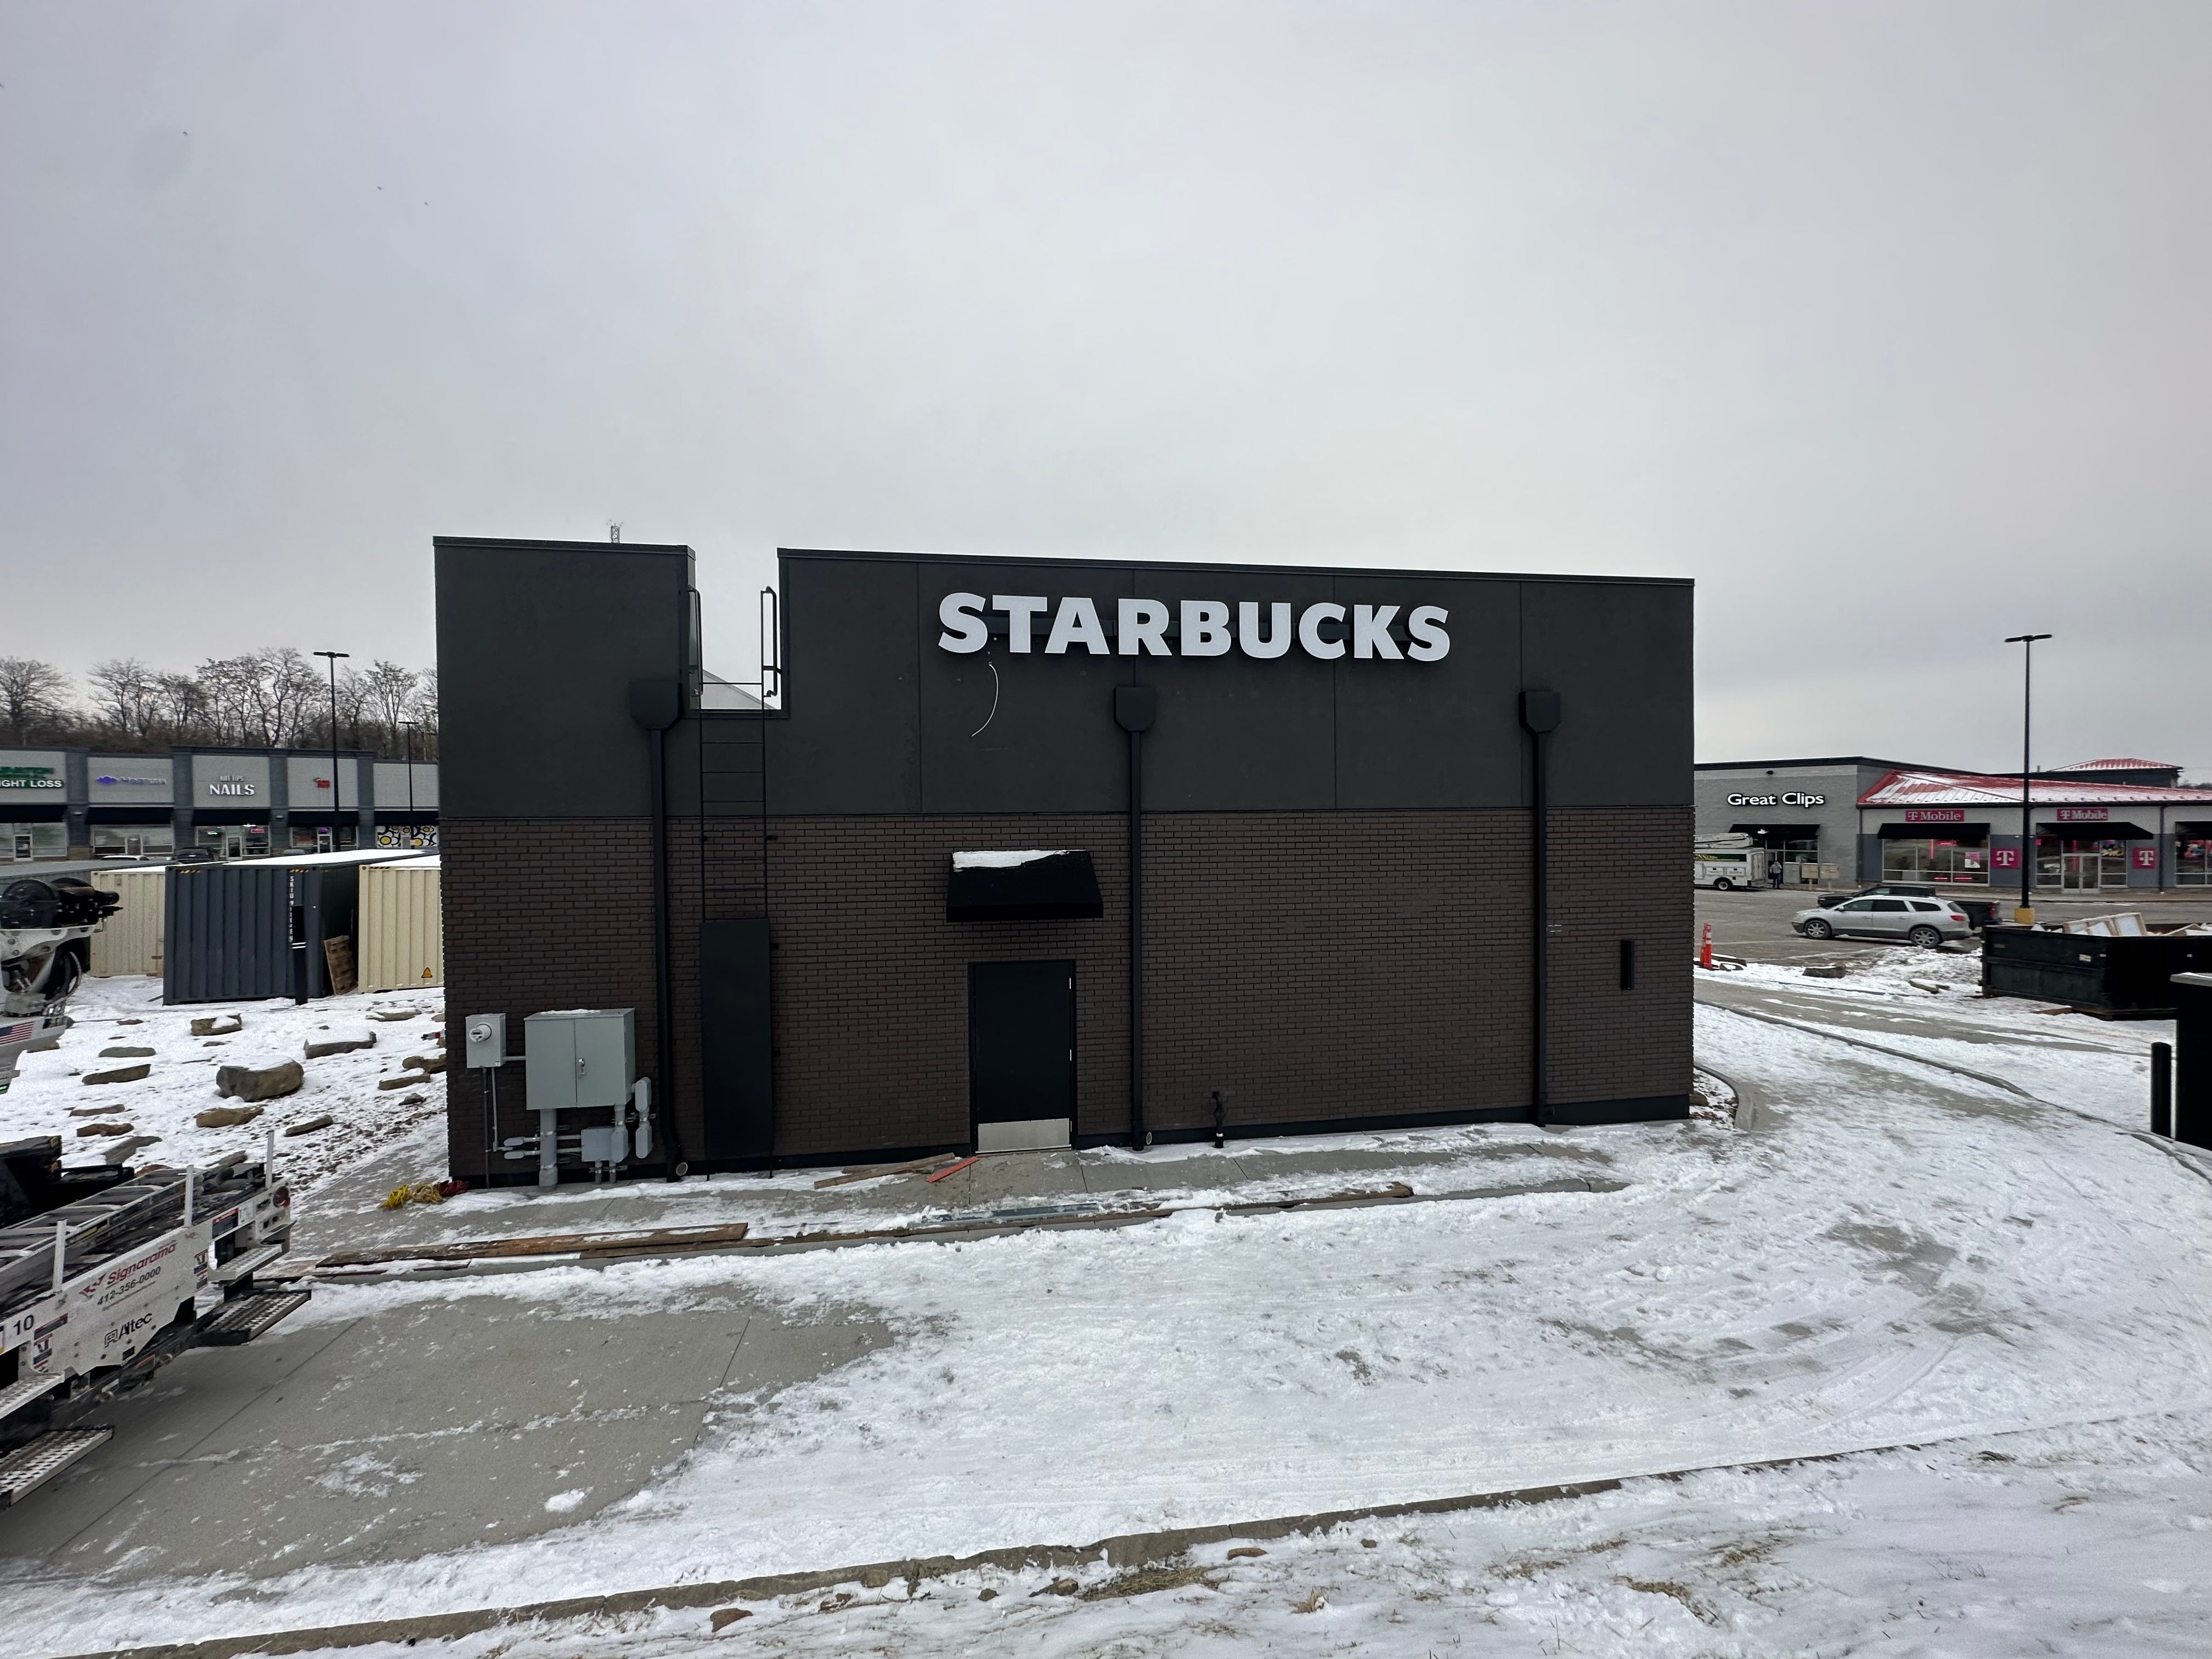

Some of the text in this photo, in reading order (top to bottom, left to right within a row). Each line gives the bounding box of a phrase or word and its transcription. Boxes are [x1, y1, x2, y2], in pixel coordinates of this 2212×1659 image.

[938, 592, 1450, 662] STARBUCKS
[210, 784, 255, 795] NAILS
[1728, 792, 1824, 808] Great Clips
[1921, 811, 1961, 821] Mobile
[1996, 851, 2014, 866] T
[107, 1243, 177, 1285] Signarama
[97, 1266, 161, 1305] 412-356-0000
[13, 1314, 34, 1335] 10
[118, 1313, 152, 1340] Altec
